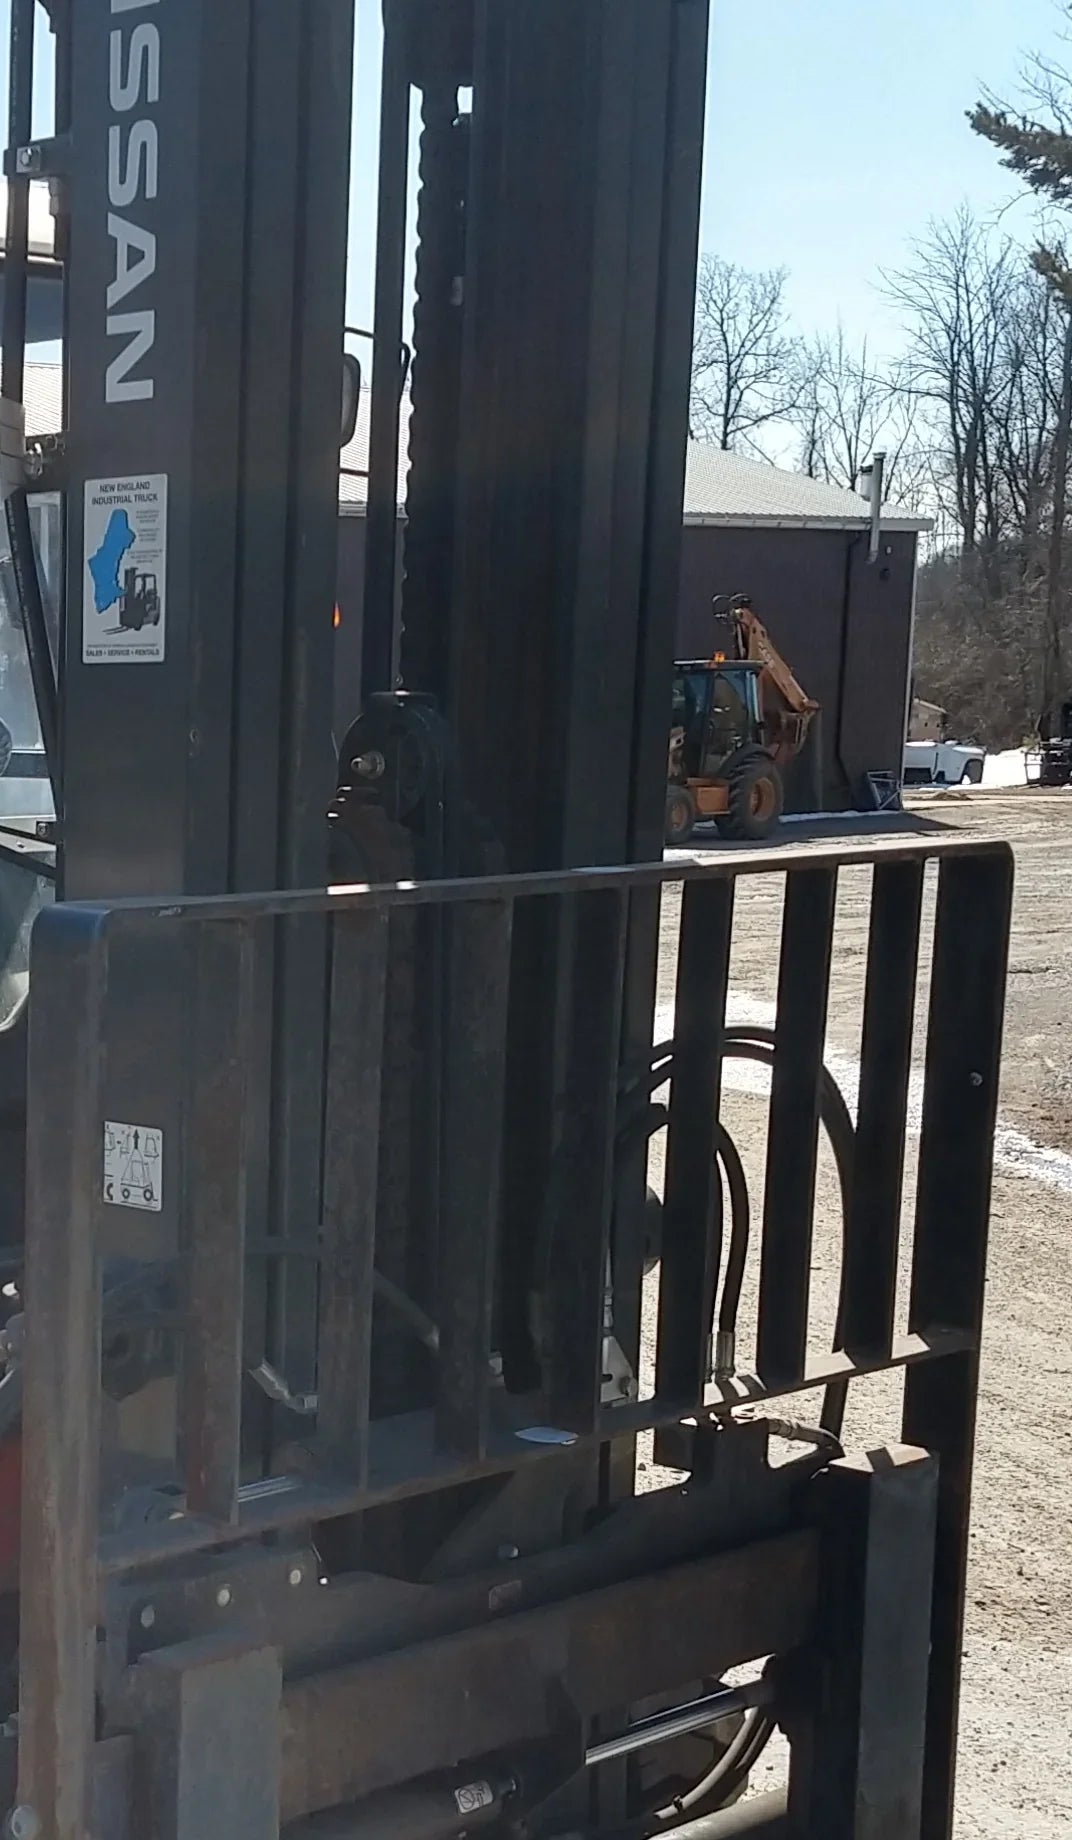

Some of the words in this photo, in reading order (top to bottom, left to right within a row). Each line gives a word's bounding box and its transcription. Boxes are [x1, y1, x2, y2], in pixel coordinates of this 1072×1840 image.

[99, 484, 115, 493] NEW
[117, 481, 151, 492] ENGLAND
[91, 494, 133, 505] INDUSTRIAL
[134, 493, 158, 503] TRUCK
[134, 648, 160, 656] RENTALS
